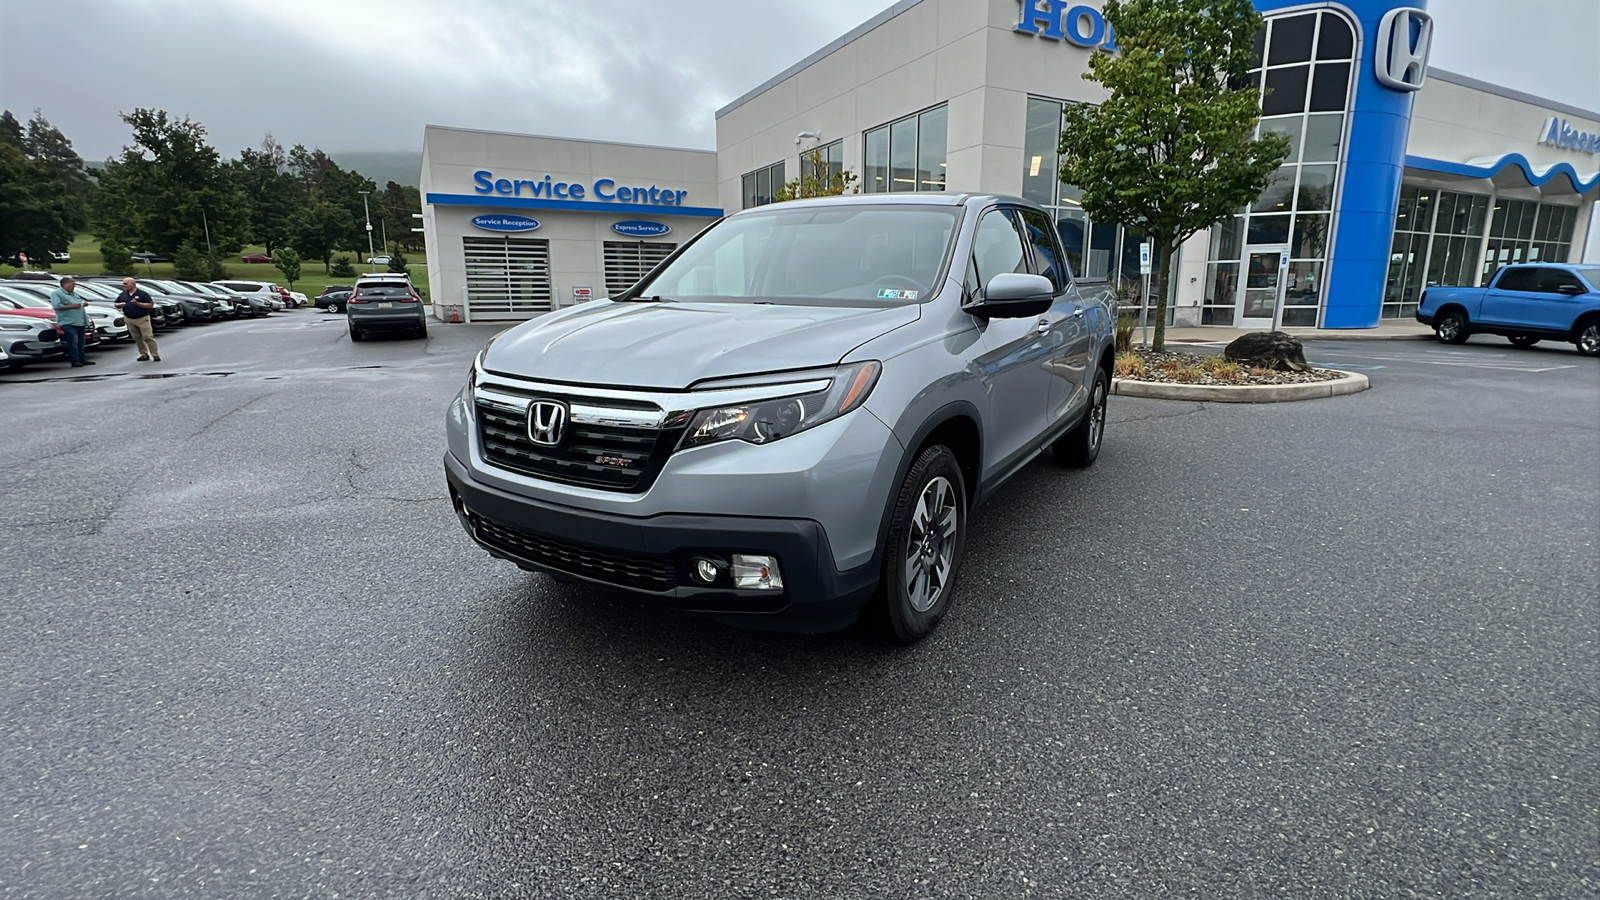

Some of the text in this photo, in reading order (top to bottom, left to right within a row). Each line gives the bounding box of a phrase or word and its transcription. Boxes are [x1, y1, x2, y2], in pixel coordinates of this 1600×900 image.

[473, 170, 688, 206] Service Center
[502, 219, 537, 228] Reception
[595, 456, 633, 467] SPORT
